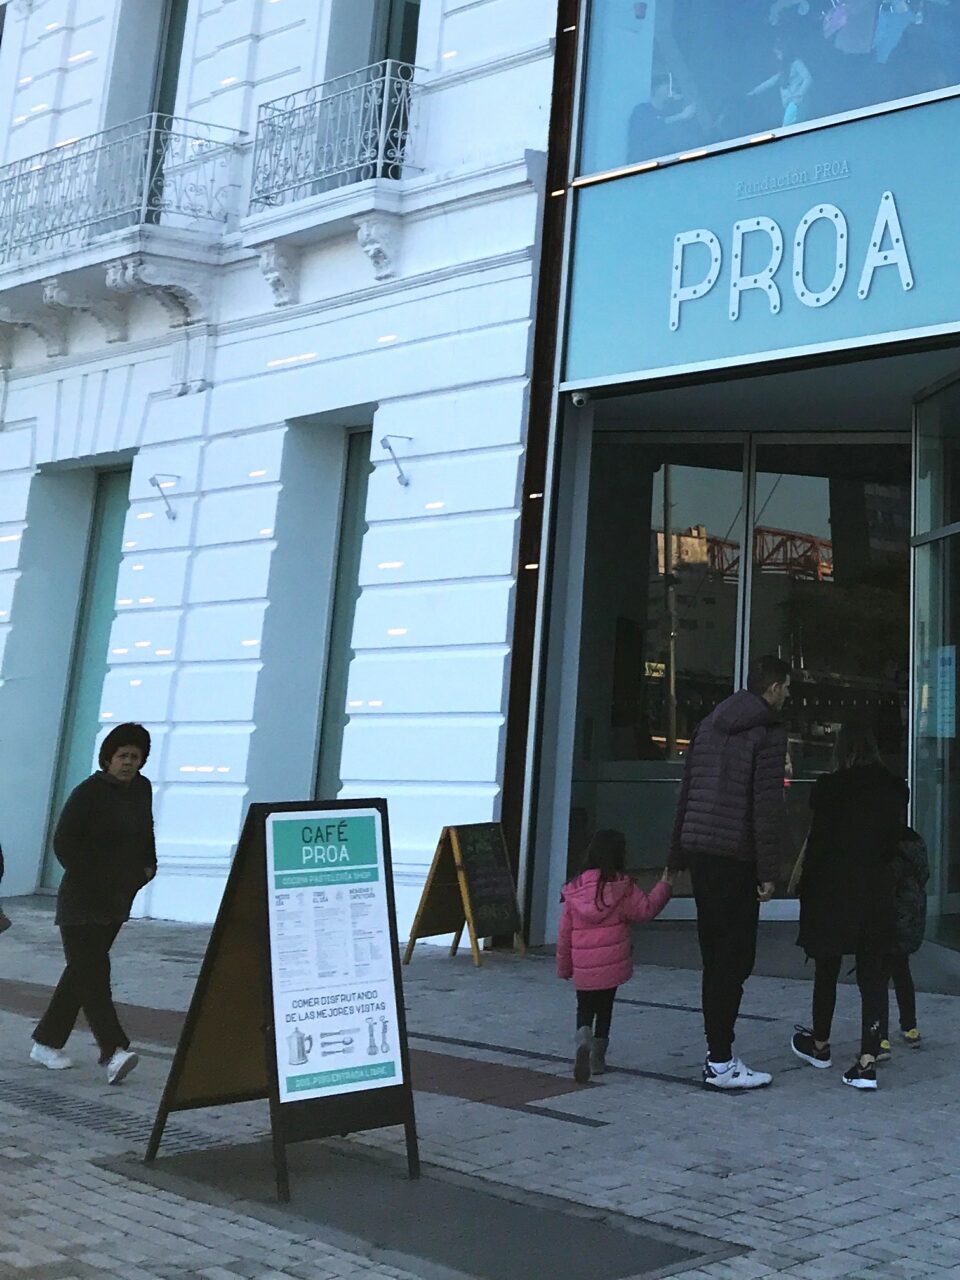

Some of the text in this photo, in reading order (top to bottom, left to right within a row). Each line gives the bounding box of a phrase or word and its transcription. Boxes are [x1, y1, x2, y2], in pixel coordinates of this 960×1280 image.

[814, 159, 849, 180] PROA
[669, 190, 915, 332] PROA
[301, 821, 349, 843] CAFÉ
[302, 844, 350, 865] PROA
[292, 990, 378, 1009] COMER DISFRUTANDO
[285, 1001, 386, 1023] DE LAS MEJORES VISTAS
